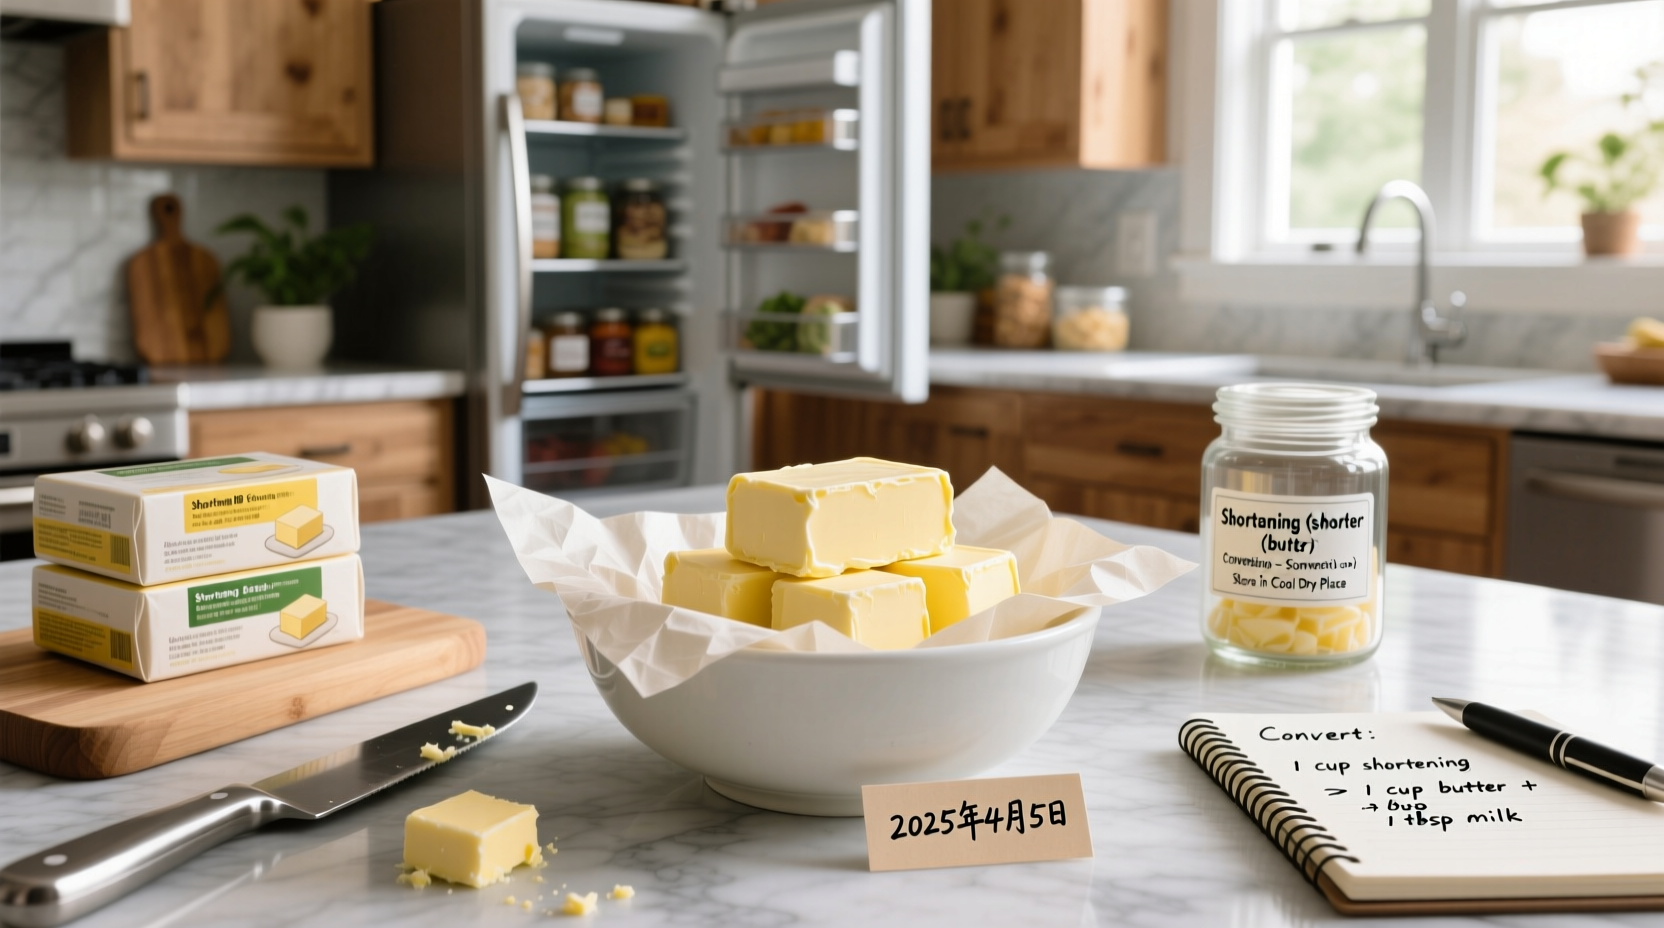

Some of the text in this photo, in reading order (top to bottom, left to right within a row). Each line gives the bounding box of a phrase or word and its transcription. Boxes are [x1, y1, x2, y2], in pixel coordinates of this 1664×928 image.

[1306, 512, 1364, 533] (shorter
[1260, 575, 1267, 587] in
[1299, 577, 1317, 592] Dry
[1320, 576, 1346, 590] Place
[1259, 726, 1376, 741] Convert:
[1315, 760, 1350, 775] cup
[1363, 757, 1471, 772] shortening
[1387, 784, 1423, 799] cup
[1439, 780, 1507, 793] butter
[890, 799, 1066, 841] 2025年4月5日
[1404, 811, 1453, 831] tbsp
[1467, 808, 1522, 823] milk
